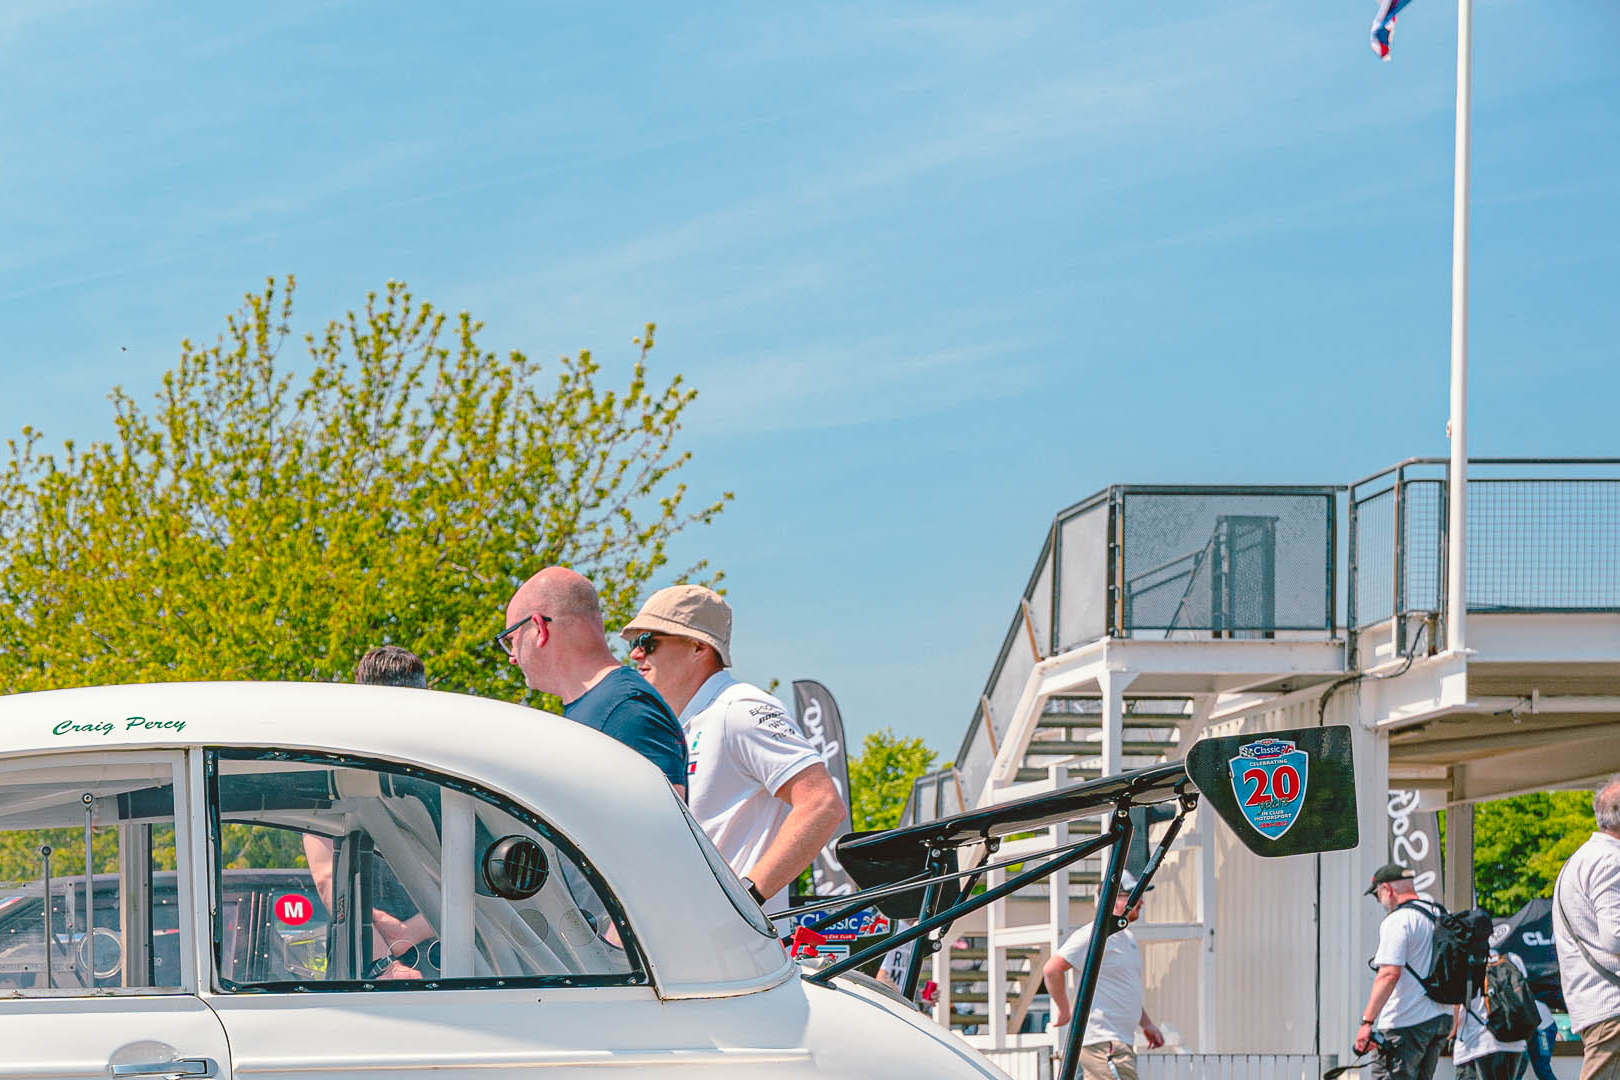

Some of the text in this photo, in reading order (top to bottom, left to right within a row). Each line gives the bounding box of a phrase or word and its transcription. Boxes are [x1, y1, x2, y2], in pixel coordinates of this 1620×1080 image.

[52, 716, 187, 736] Craig Percy
[1254, 746, 1280, 755] Classic
[1249, 759, 1288, 767] CELEBRATING
[1243, 765, 1300, 806] 20
[1254, 813, 1292, 821] MOTORSPORT
[284, 902, 303, 918] M
